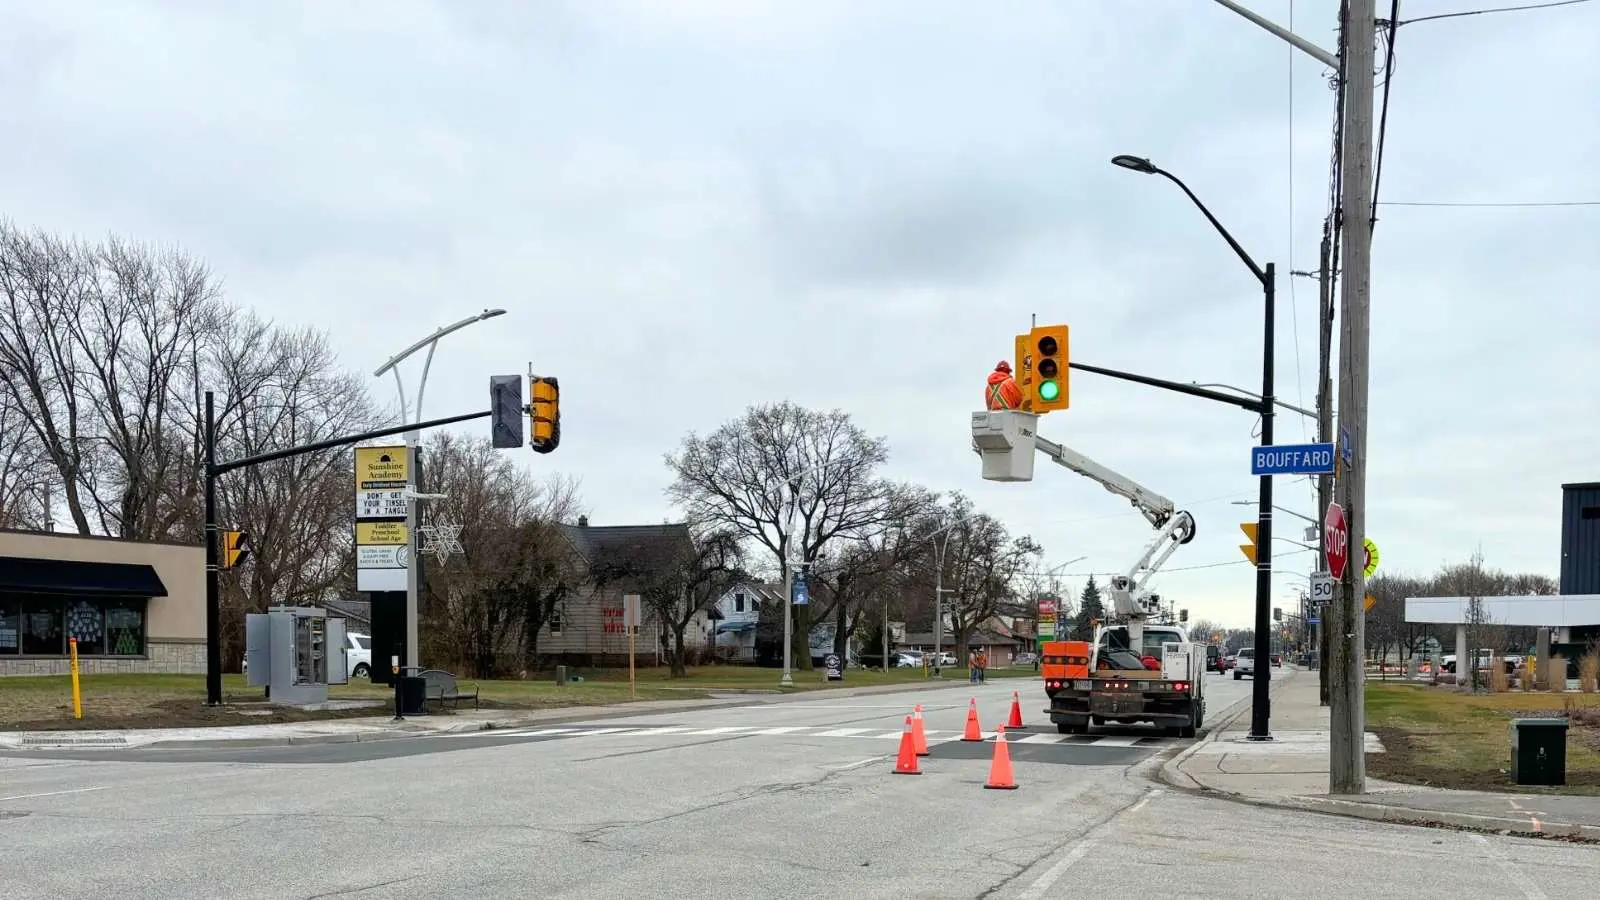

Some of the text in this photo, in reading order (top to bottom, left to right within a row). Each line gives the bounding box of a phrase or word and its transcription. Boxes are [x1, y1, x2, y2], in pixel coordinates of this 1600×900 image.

[1256, 451, 1331, 468] BOUFFARD
[368, 462, 404, 471] Sunshine
[369, 471, 402, 480] Academy
[367, 492, 383, 500] DONT
[386, 499, 406, 507] TINSEL
[385, 506, 408, 515] TANGLE
[1326, 525, 1346, 556] STOP
[1314, 582, 1331, 597] 50
